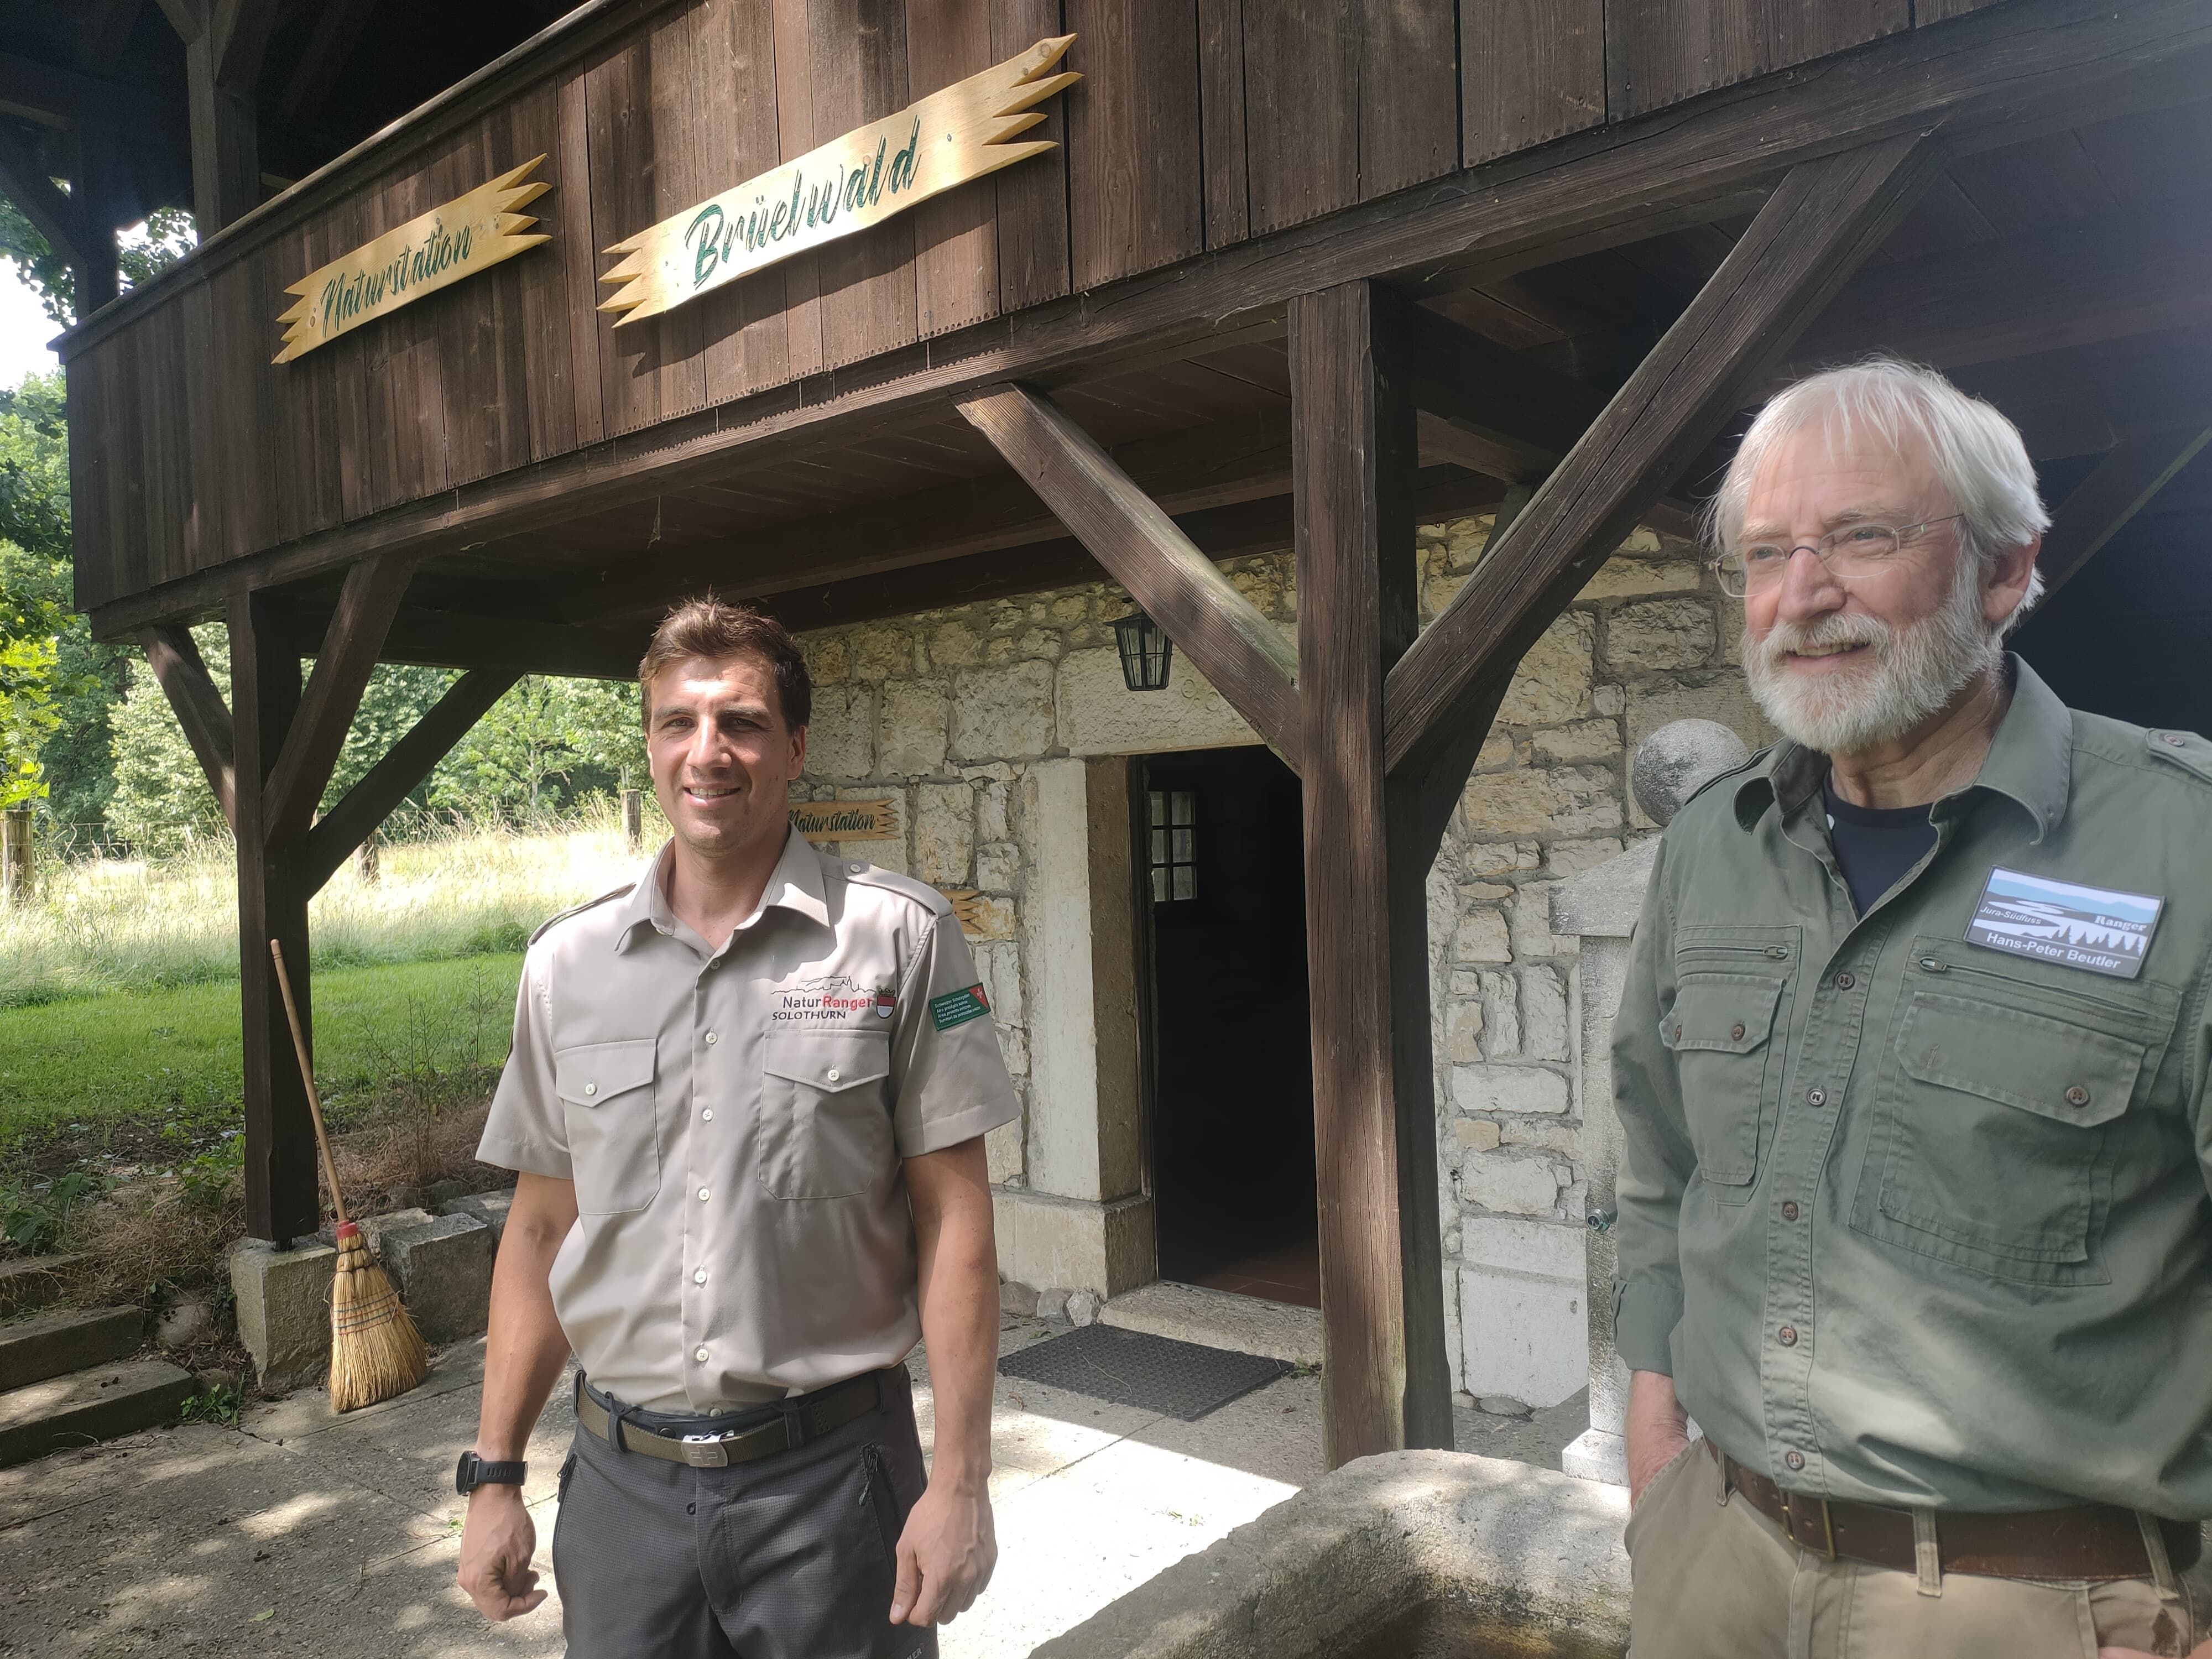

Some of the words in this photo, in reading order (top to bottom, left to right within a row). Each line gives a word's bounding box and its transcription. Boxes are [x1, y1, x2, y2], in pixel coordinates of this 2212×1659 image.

[685, 114, 922, 290] Brüelwald
[320, 223, 473, 338] Naturstation
[788, 808, 876, 833] Naturstation
[1980, 906, 2041, 925] Jura-Südfuss
[2094, 915, 2147, 932] Ranger
[1986, 932, 2064, 957] Hans-Peter
[2067, 950, 2121, 969] Beutler
[772, 1010, 846, 1020] SOLOTHURN
[782, 994, 874, 1011] NaturRanger
